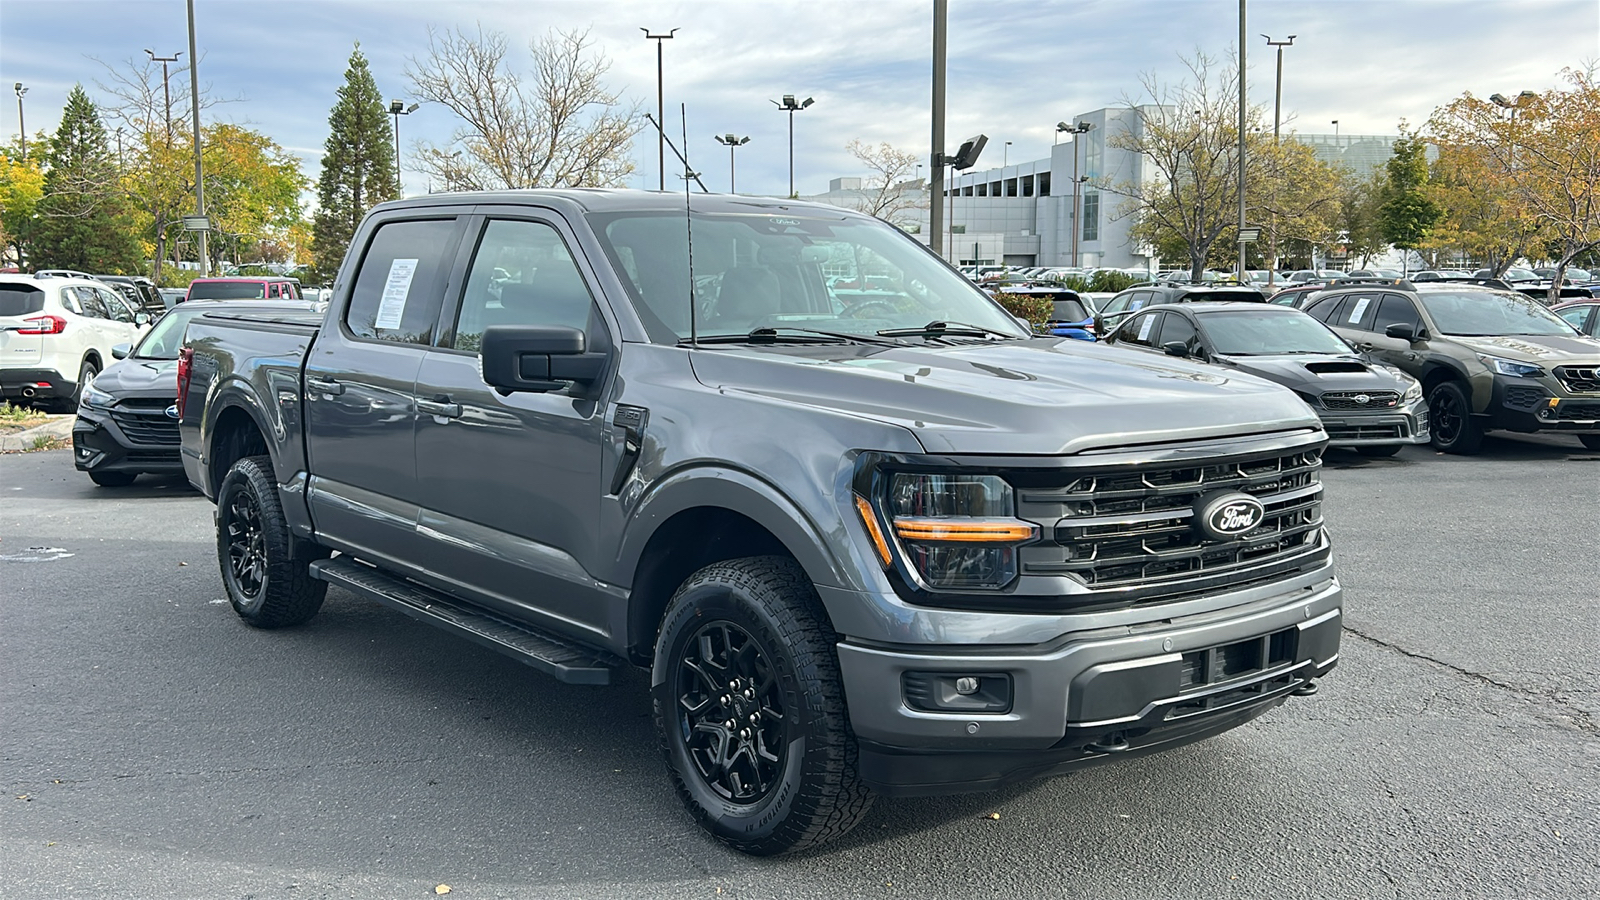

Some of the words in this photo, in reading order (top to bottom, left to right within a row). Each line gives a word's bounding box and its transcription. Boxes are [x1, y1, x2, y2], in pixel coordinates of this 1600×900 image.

[615, 410, 641, 420] F-150
[1220, 504, 1255, 530] Ford
[759, 781, 791, 828] TERRITORY
